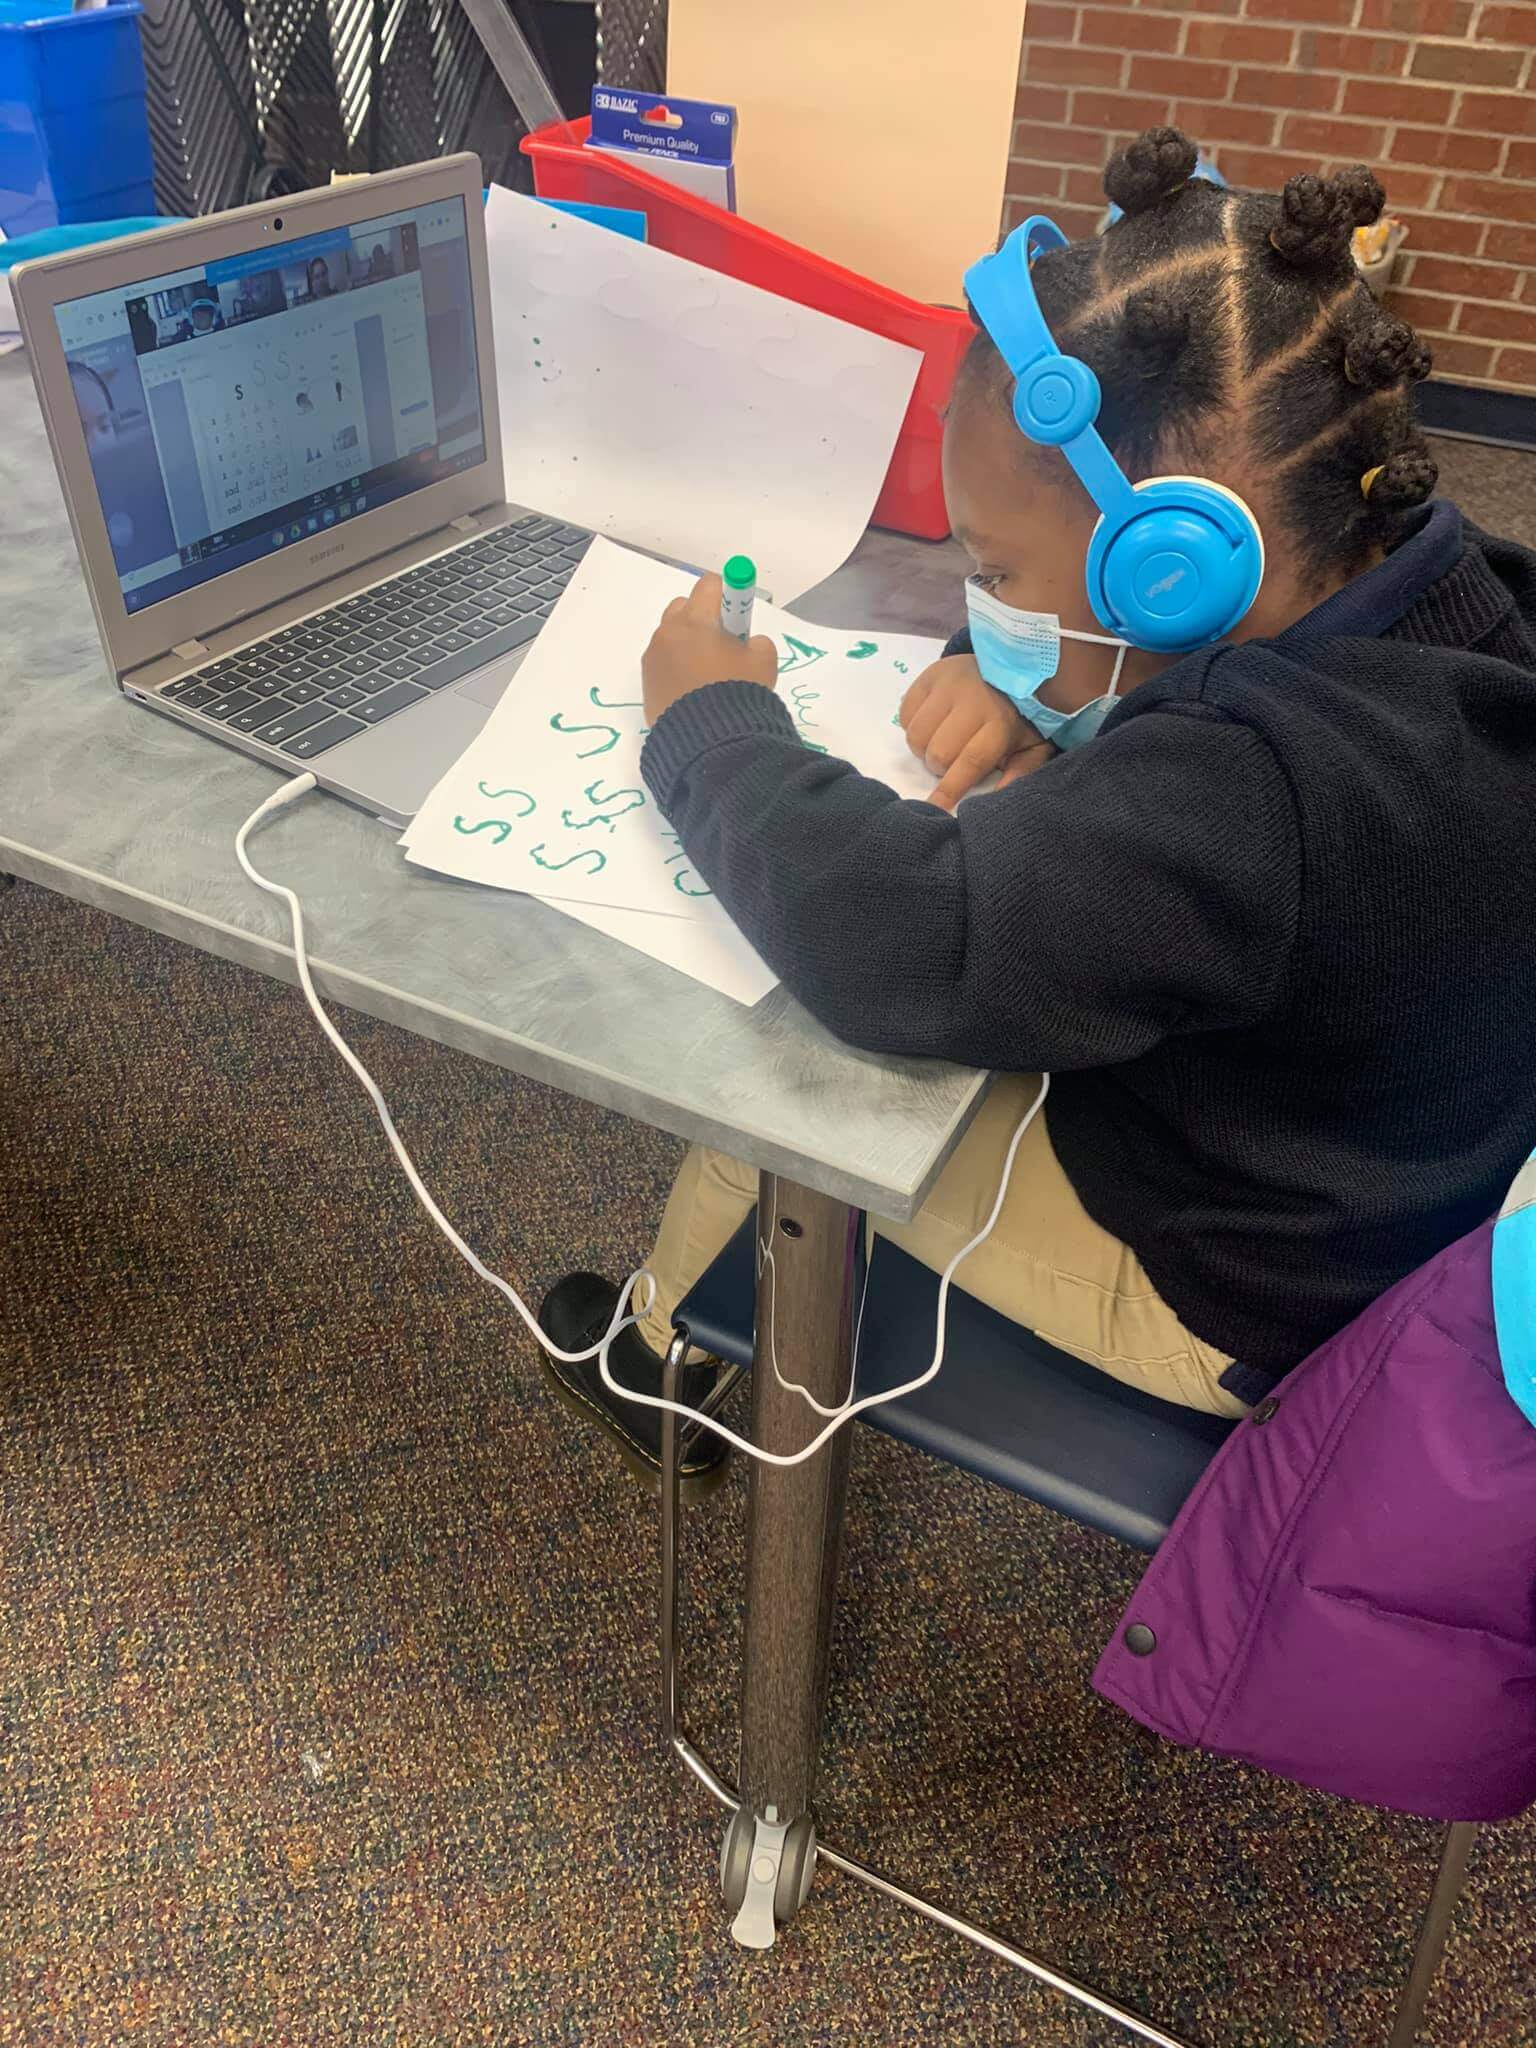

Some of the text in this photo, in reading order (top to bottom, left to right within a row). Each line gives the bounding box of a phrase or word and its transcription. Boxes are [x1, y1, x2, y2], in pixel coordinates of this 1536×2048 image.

[610, 95, 639, 110] BAZIC
[623, 128, 666, 147] Premium
[667, 136, 699, 154] Quality
